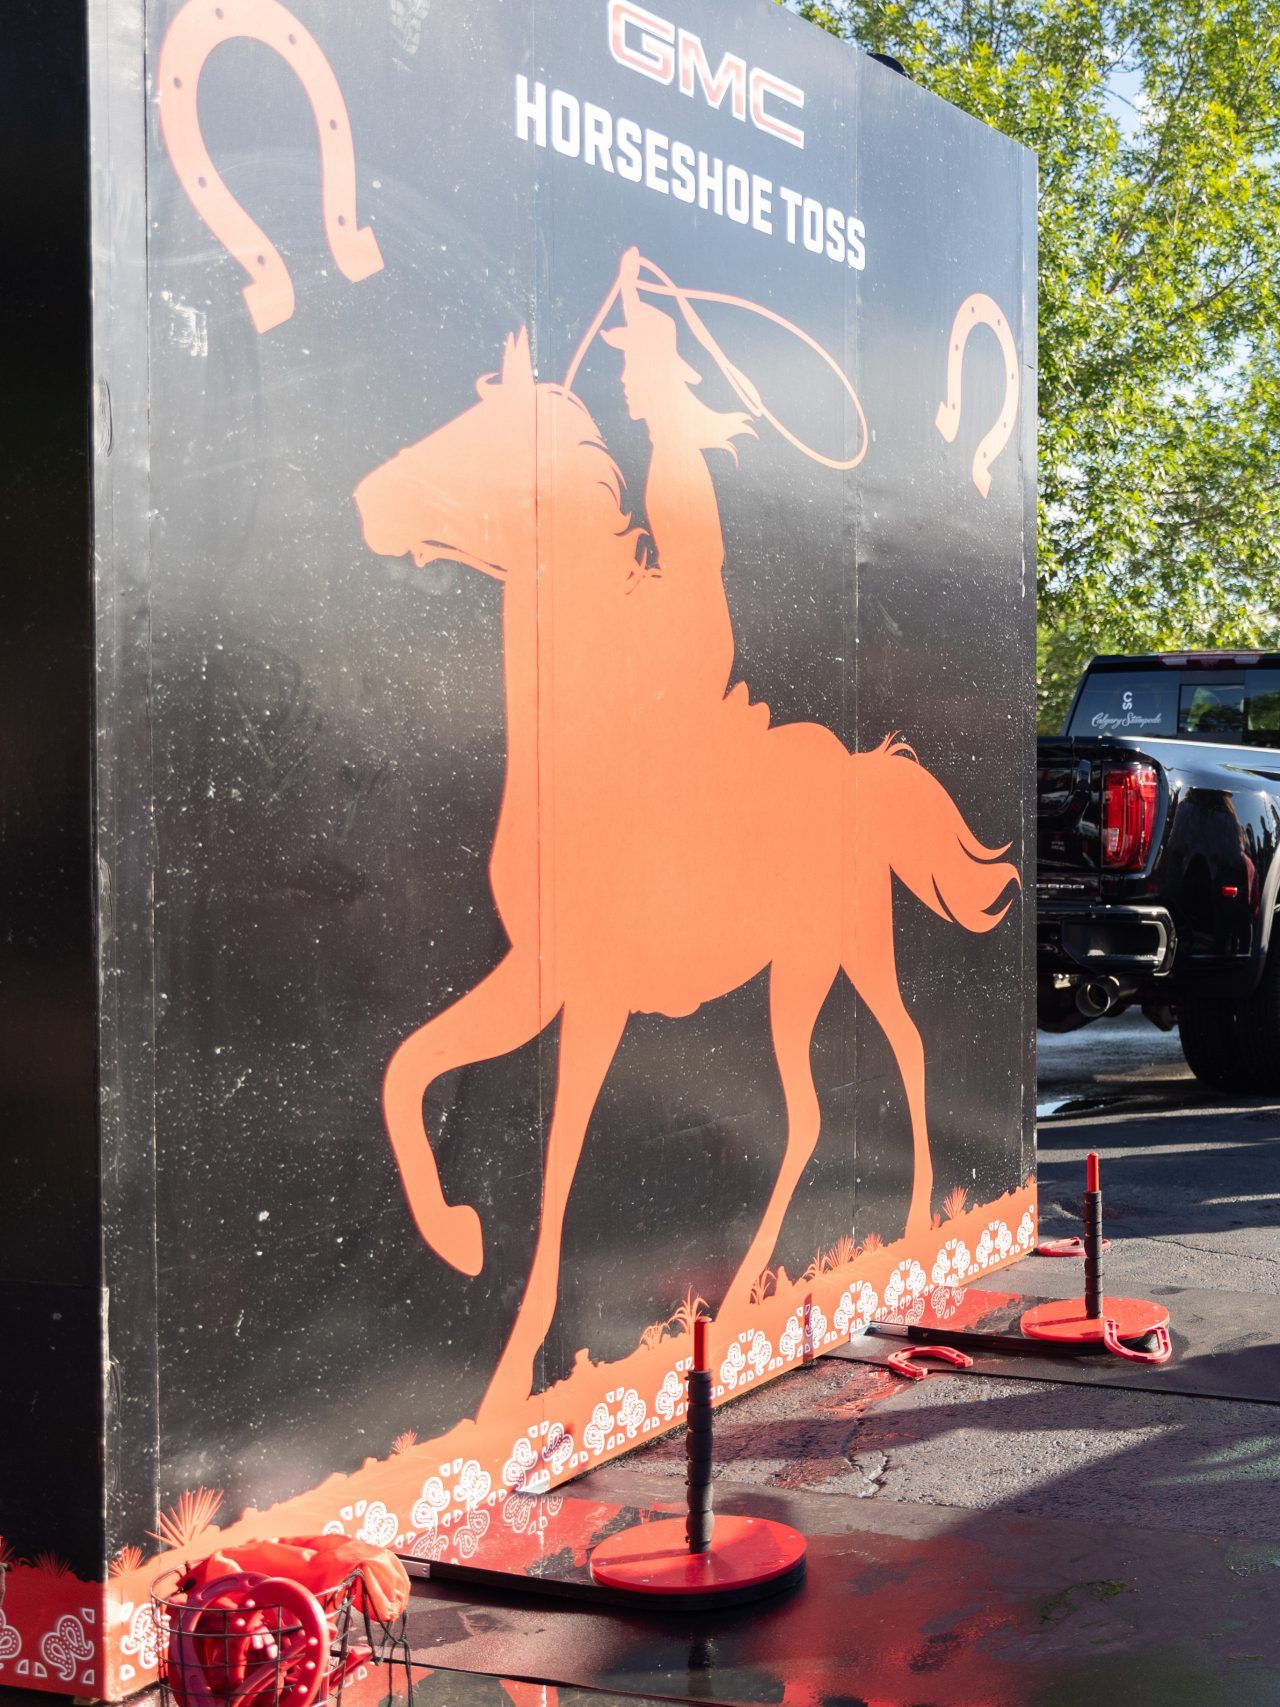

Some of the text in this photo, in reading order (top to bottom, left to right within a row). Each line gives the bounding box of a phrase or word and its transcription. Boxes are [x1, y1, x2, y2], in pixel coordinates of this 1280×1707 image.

[608, 0, 805, 150] GMC
[515, 73, 866, 271] HORSESHOE TOSS
